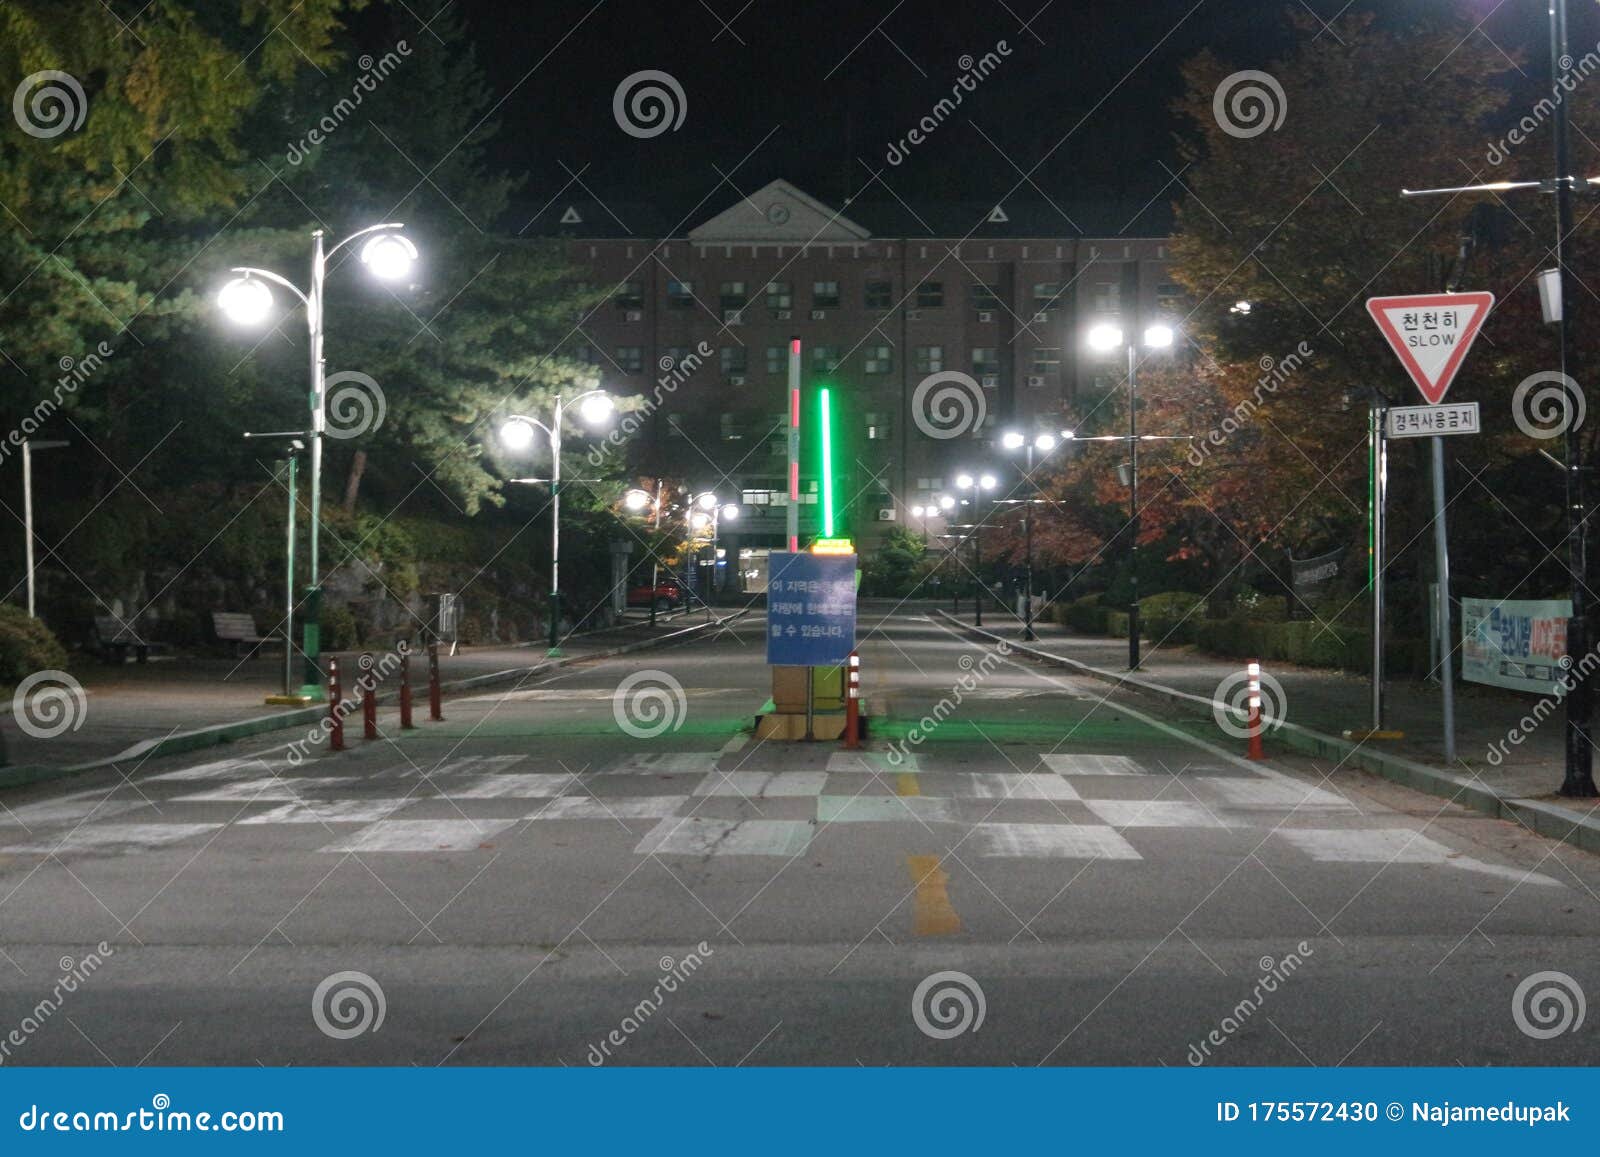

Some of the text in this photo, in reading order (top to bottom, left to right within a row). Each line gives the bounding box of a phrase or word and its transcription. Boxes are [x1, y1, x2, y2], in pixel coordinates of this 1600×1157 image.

[1403, 311, 1458, 331] 천천히
[1409, 335, 1456, 347] SLOW
[772, 580, 783, 592] 이
[784, 624, 797, 637] 수
